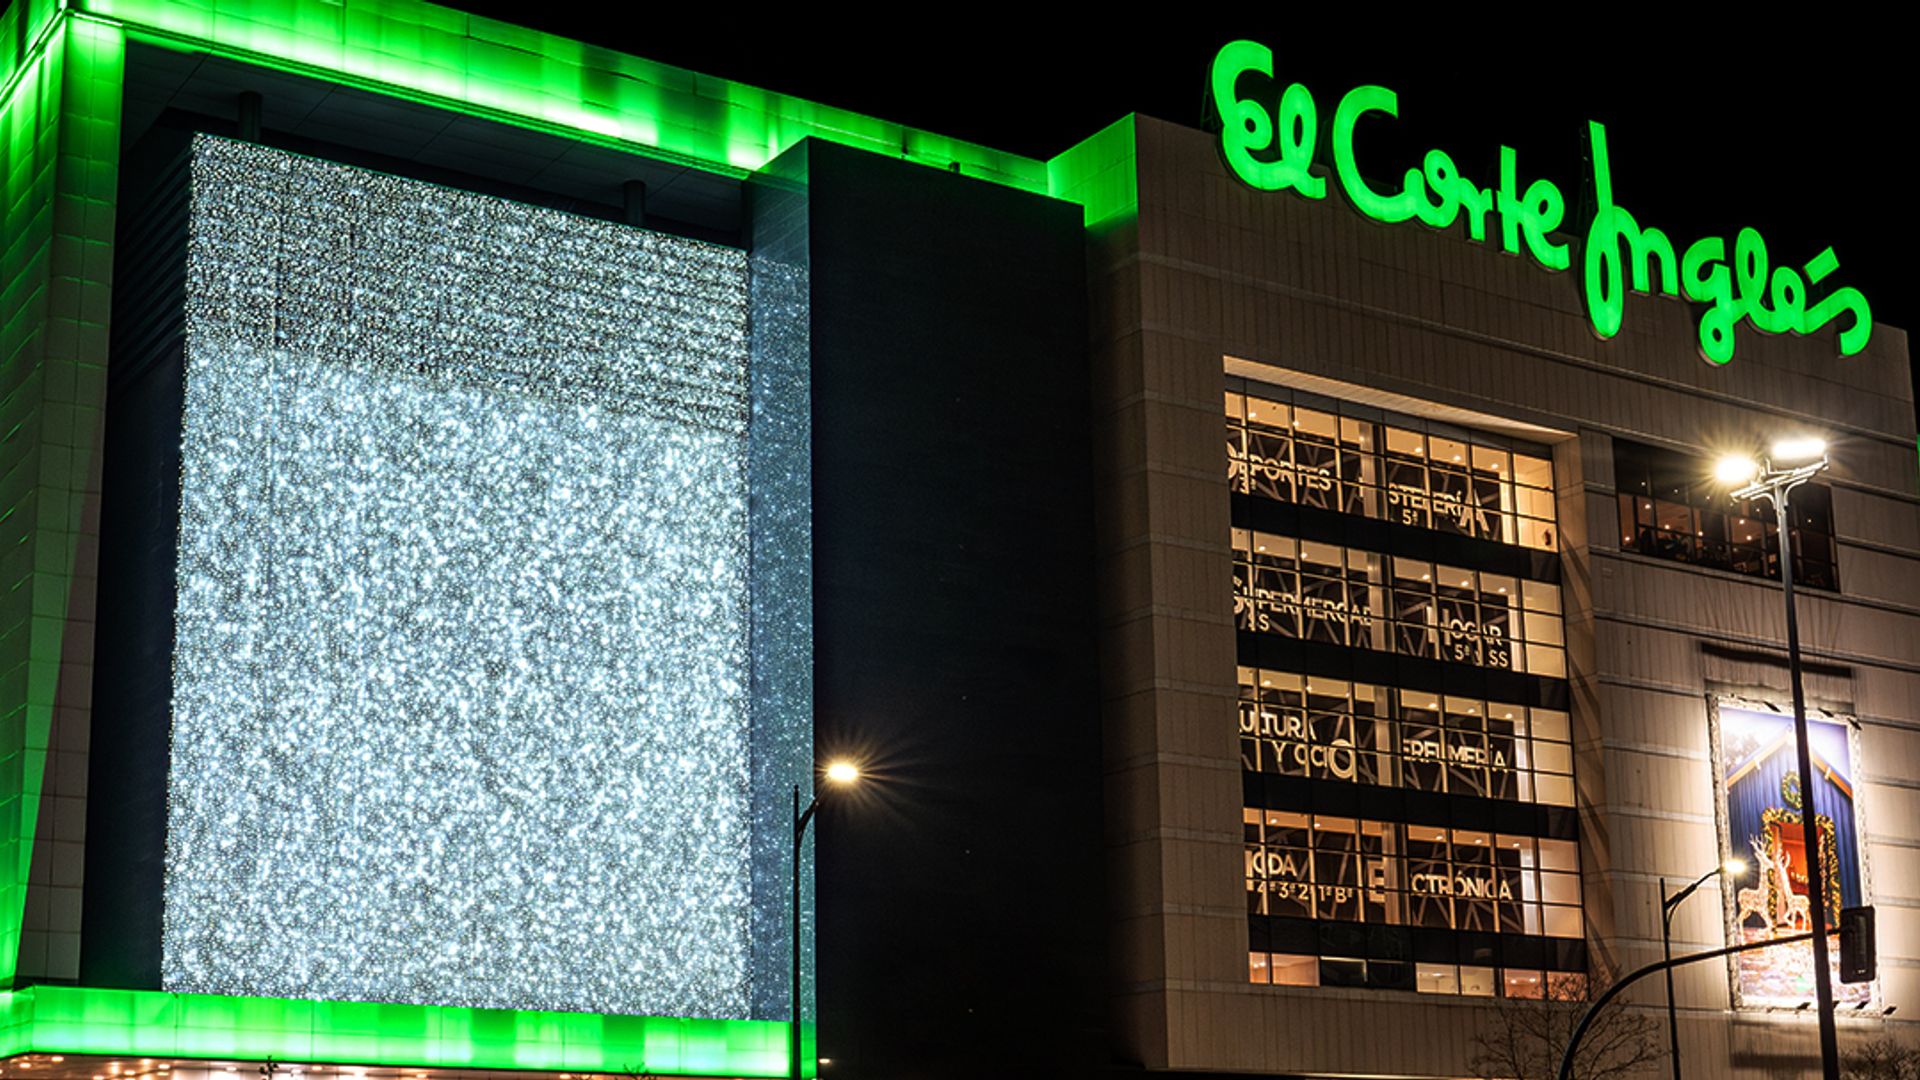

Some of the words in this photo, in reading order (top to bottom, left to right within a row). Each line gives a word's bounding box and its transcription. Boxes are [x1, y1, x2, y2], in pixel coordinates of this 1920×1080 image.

[1212, 40, 1326, 199] El
[1333, 85, 1570, 272] Corte
[1585, 120, 1872, 365] Inglés
[1271, 740, 1287, 763] Y
